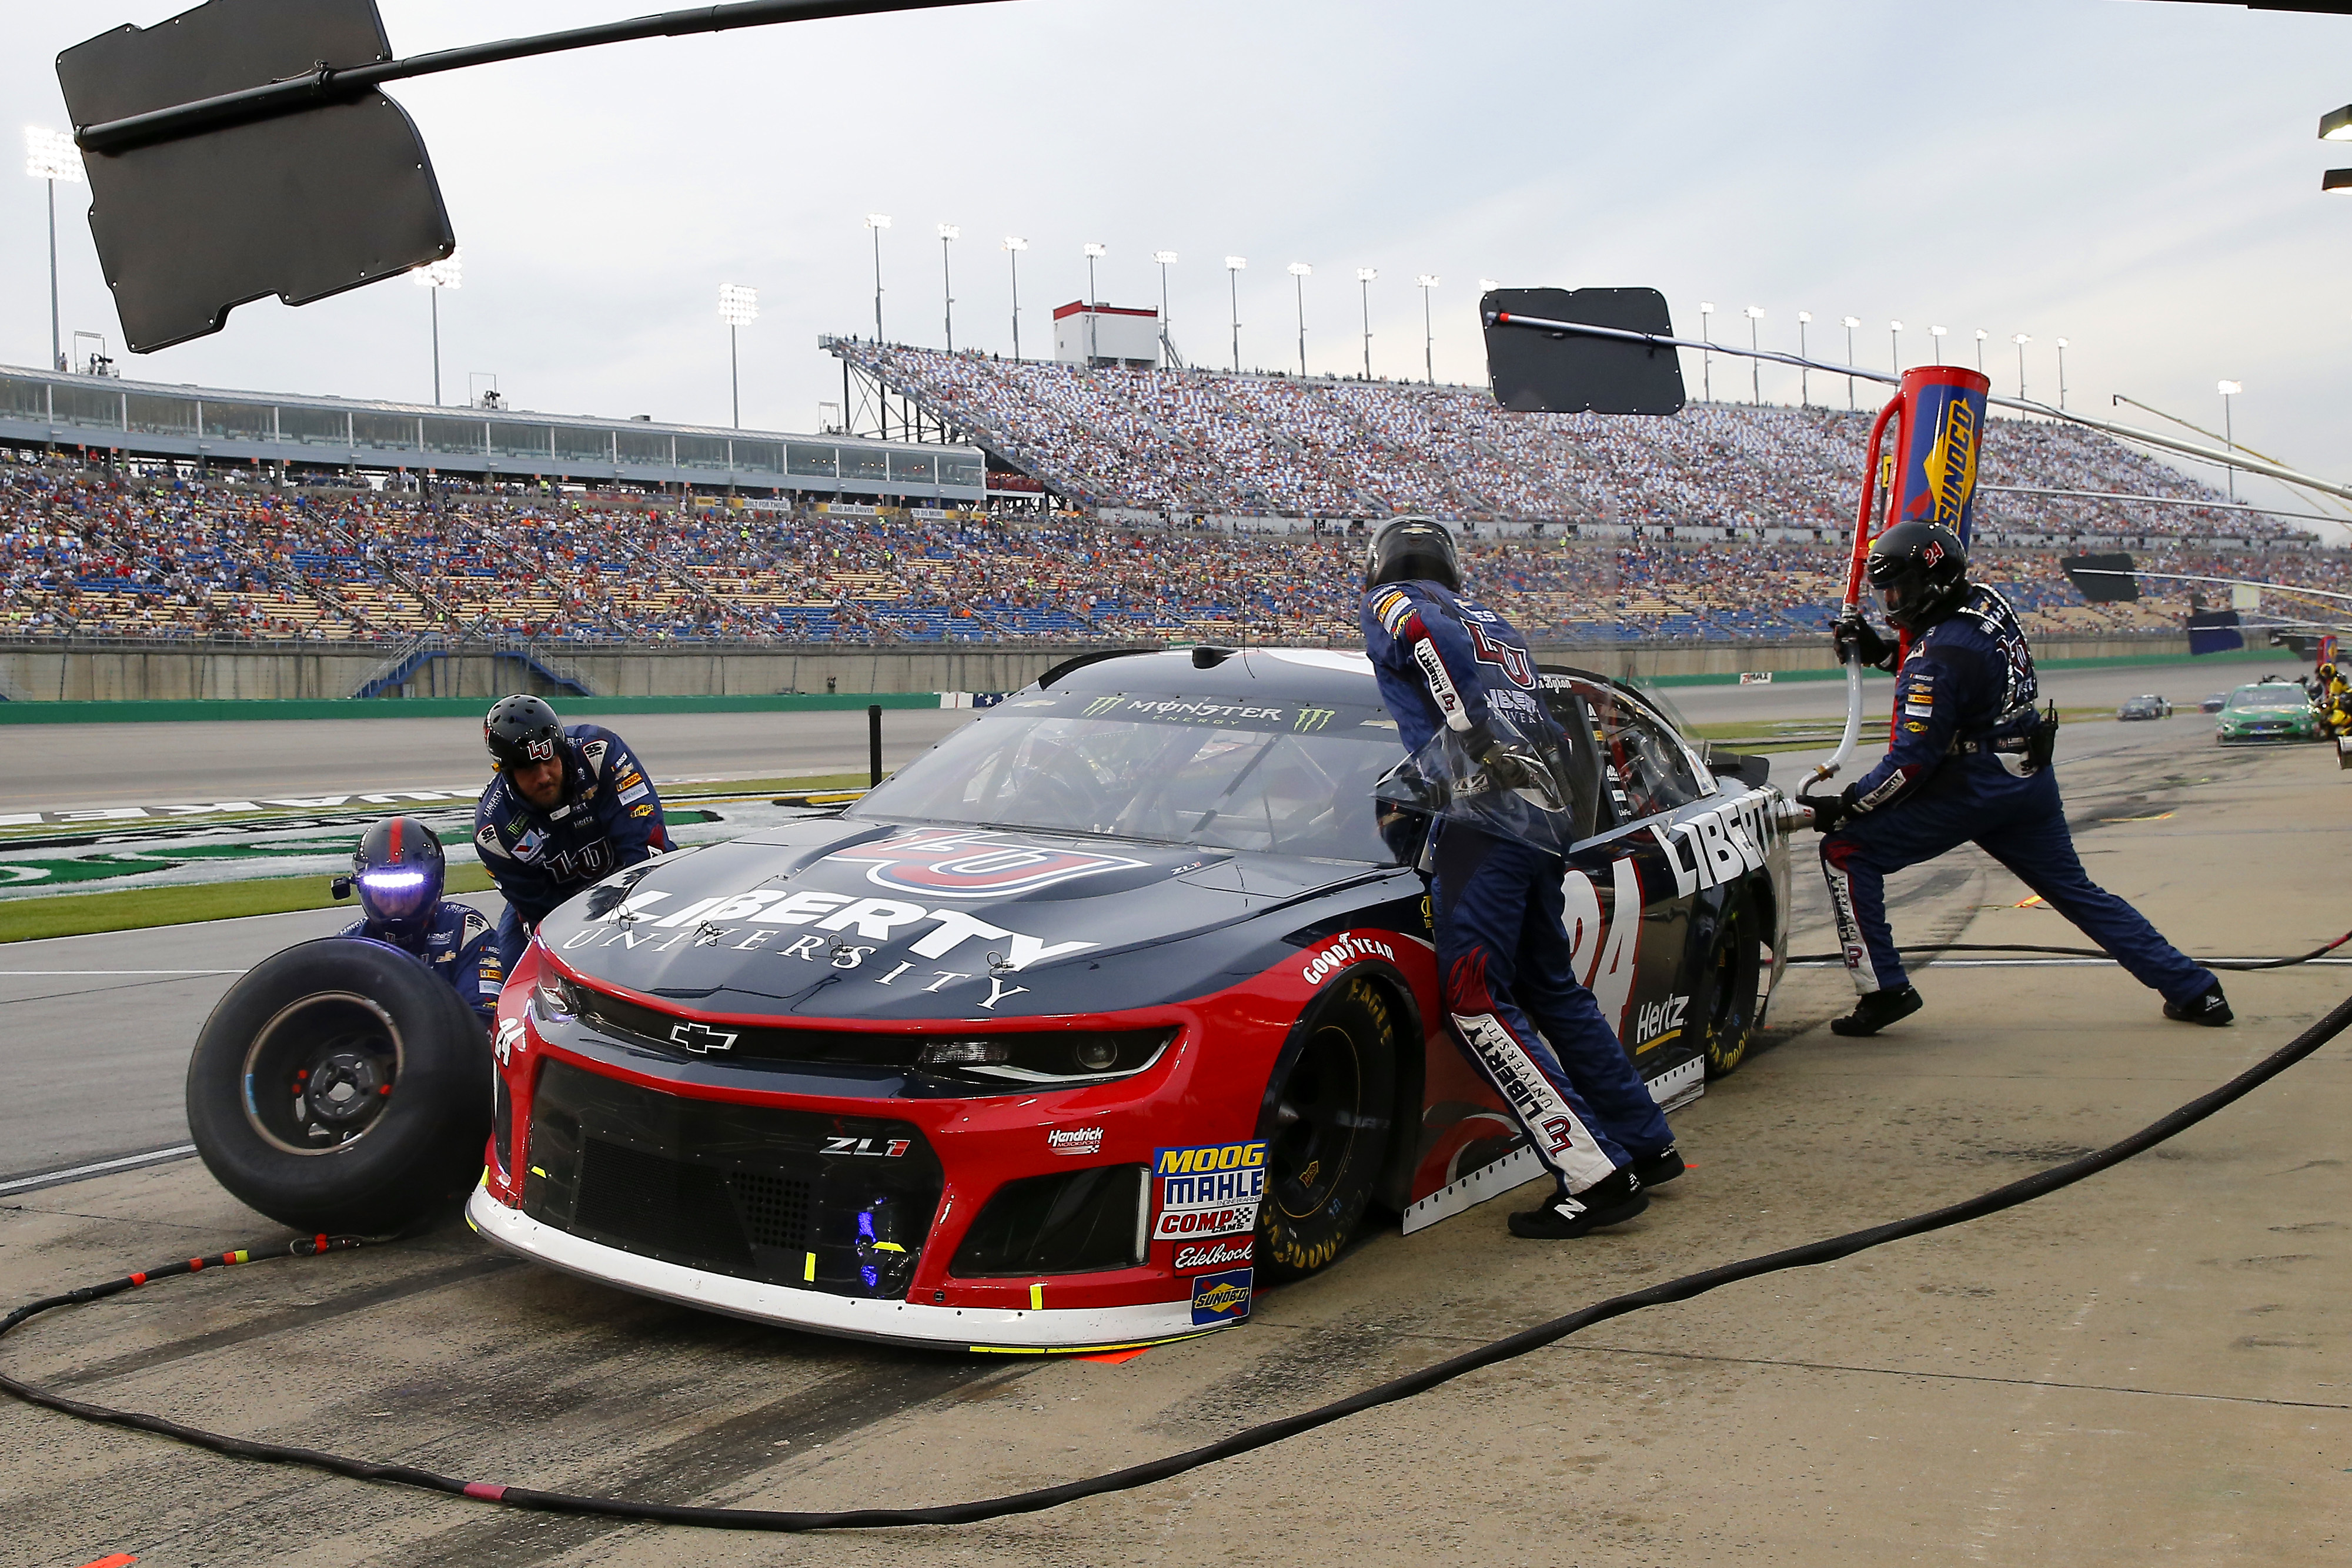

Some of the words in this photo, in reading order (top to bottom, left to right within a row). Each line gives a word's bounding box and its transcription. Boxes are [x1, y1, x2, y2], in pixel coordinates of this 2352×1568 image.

[1939, 404, 1973, 532] SUNOCO
[1923, 540, 1945, 568] 24
[1416, 646, 1444, 694] LIBERTY
[1544, 676, 1572, 694] Byron
[1152, 715, 1241, 726] ENERGY
[527, 738, 554, 760] LU
[624, 774, 641, 787] BOSCH
[483, 788, 501, 817] LIBERTY
[630, 804, 654, 818] SUNOCO
[573, 815, 594, 827] Hertz
[597, 890, 1101, 973] LIBERTY
[562, 928, 1031, 1011] UNIVERSITY
[1302, 938, 1395, 985] GOODYEAR
[1636, 993, 1690, 1044] Hertz
[1462, 1027, 1544, 1121] LIBERTY
[1481, 1019, 1553, 1109] UNIVERSITY
[819, 1136, 911, 1158] ZL1
[1047, 1126, 1104, 1147] Hendrick
[1541, 1115, 1575, 1158] LU
[1158, 1142, 1267, 1174] MOOG
[1166, 1170, 1264, 1205] MAHLE
[1217, 1197, 1235, 1206] ENGINE
[1237, 1195, 1262, 1204] BEARINGS
[1160, 1209, 1235, 1234] COMP
[1211, 1222, 1244, 1234] CAMS
[1175, 1241, 1253, 1271] Edelbrock
[1194, 1287, 1249, 1309] SUNOCO
